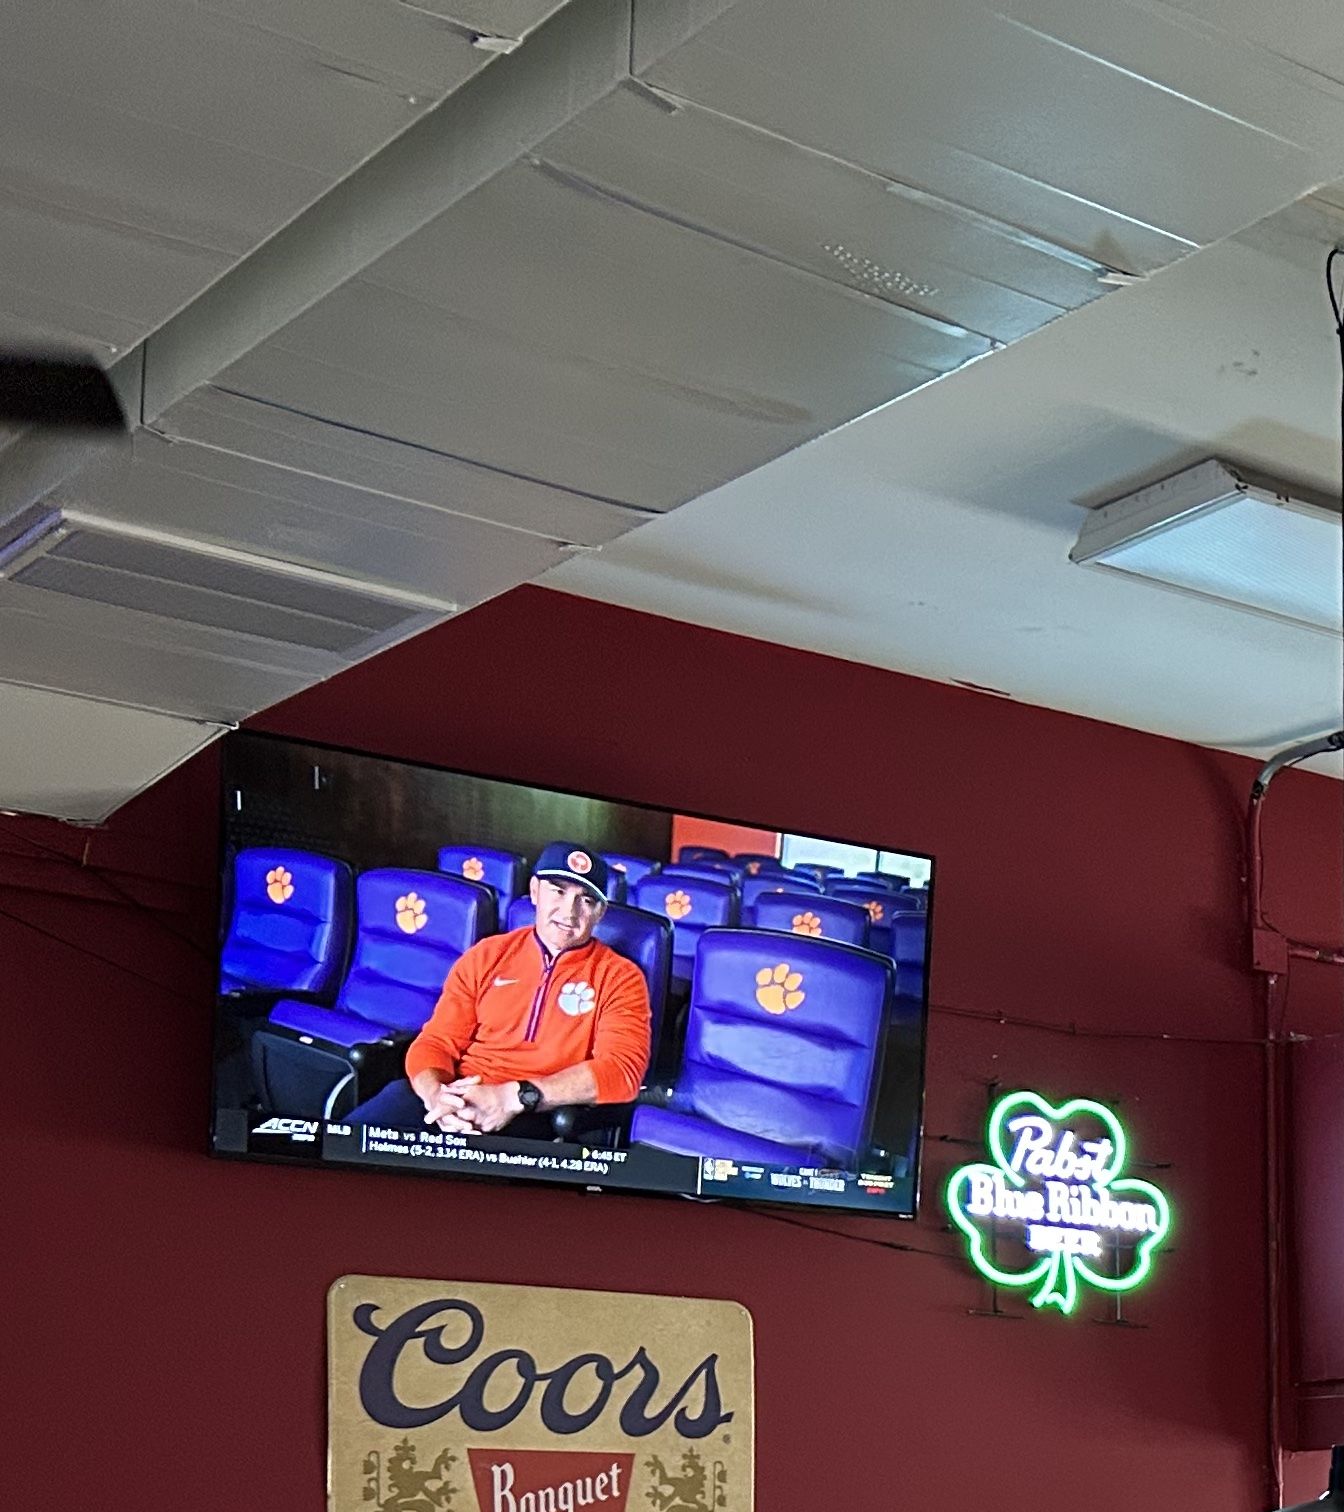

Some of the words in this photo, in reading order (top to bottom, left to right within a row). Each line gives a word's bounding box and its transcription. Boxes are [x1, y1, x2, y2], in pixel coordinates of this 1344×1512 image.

[258, 1118, 319, 1134] ACCN
[326, 1124, 351, 1136] MLB
[369, 1127, 399, 1140] Mets
[403, 1131, 416, 1142] vs
[420, 1131, 443, 1144] Red
[445, 1134, 467, 1146] Sox
[458, 1149, 484, 1162] ERA)
[1007, 1114, 1113, 1181] Pabst
[966, 1172, 1045, 1221] Blue
[1045, 1180, 1160, 1233] Ribbon
[353, 1298, 735, 1439] Coors
